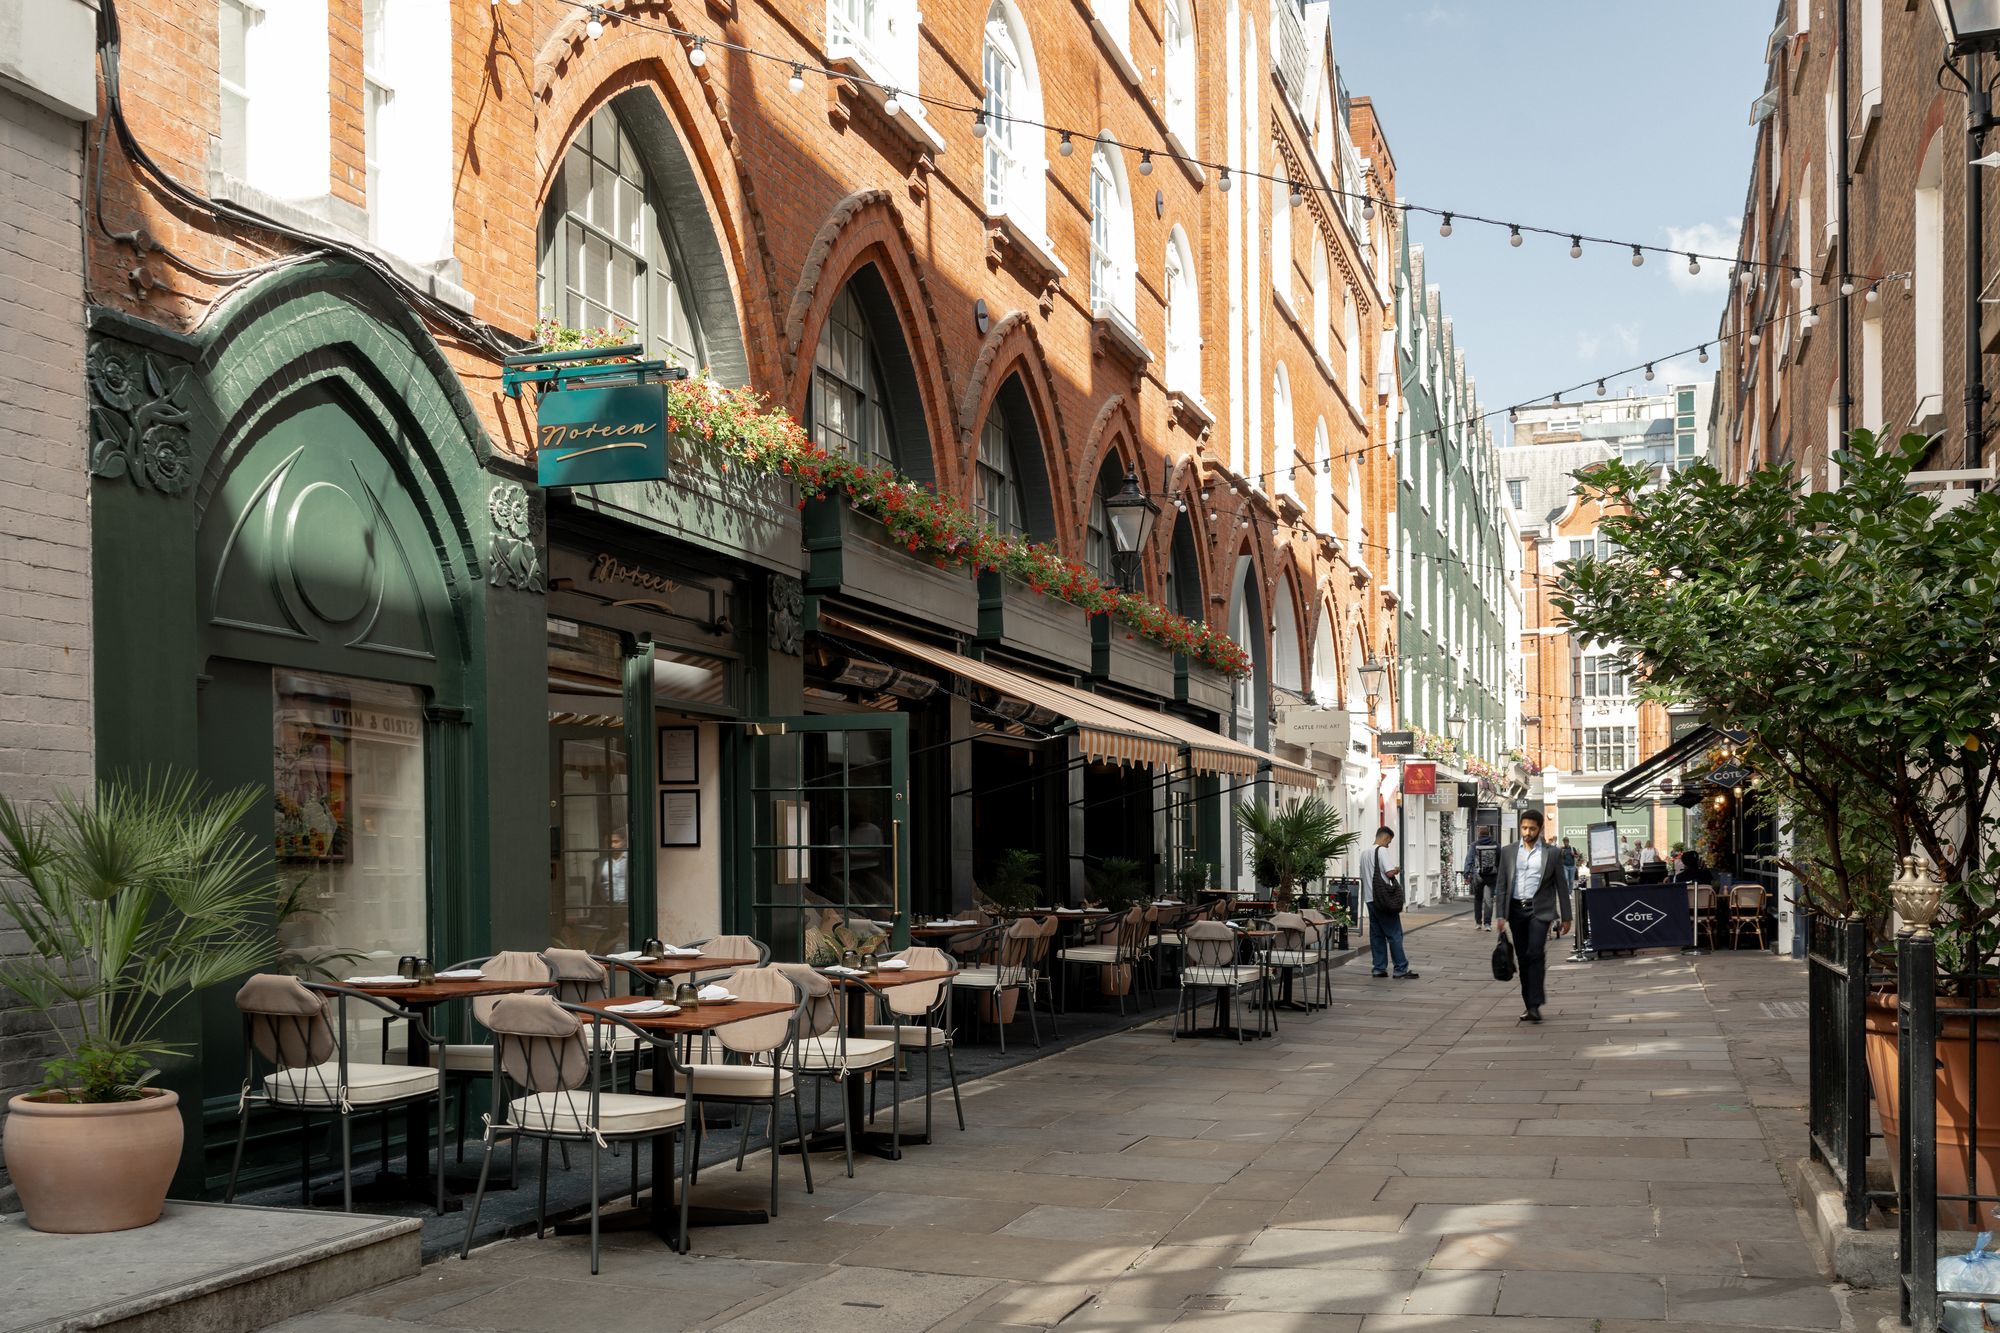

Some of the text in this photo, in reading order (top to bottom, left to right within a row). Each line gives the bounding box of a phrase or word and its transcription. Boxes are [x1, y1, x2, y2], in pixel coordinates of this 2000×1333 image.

[1713, 770, 1742, 781] CÔTE
[1619, 827, 1640, 835] SOON
[1625, 911, 1654, 922] CÔTE
